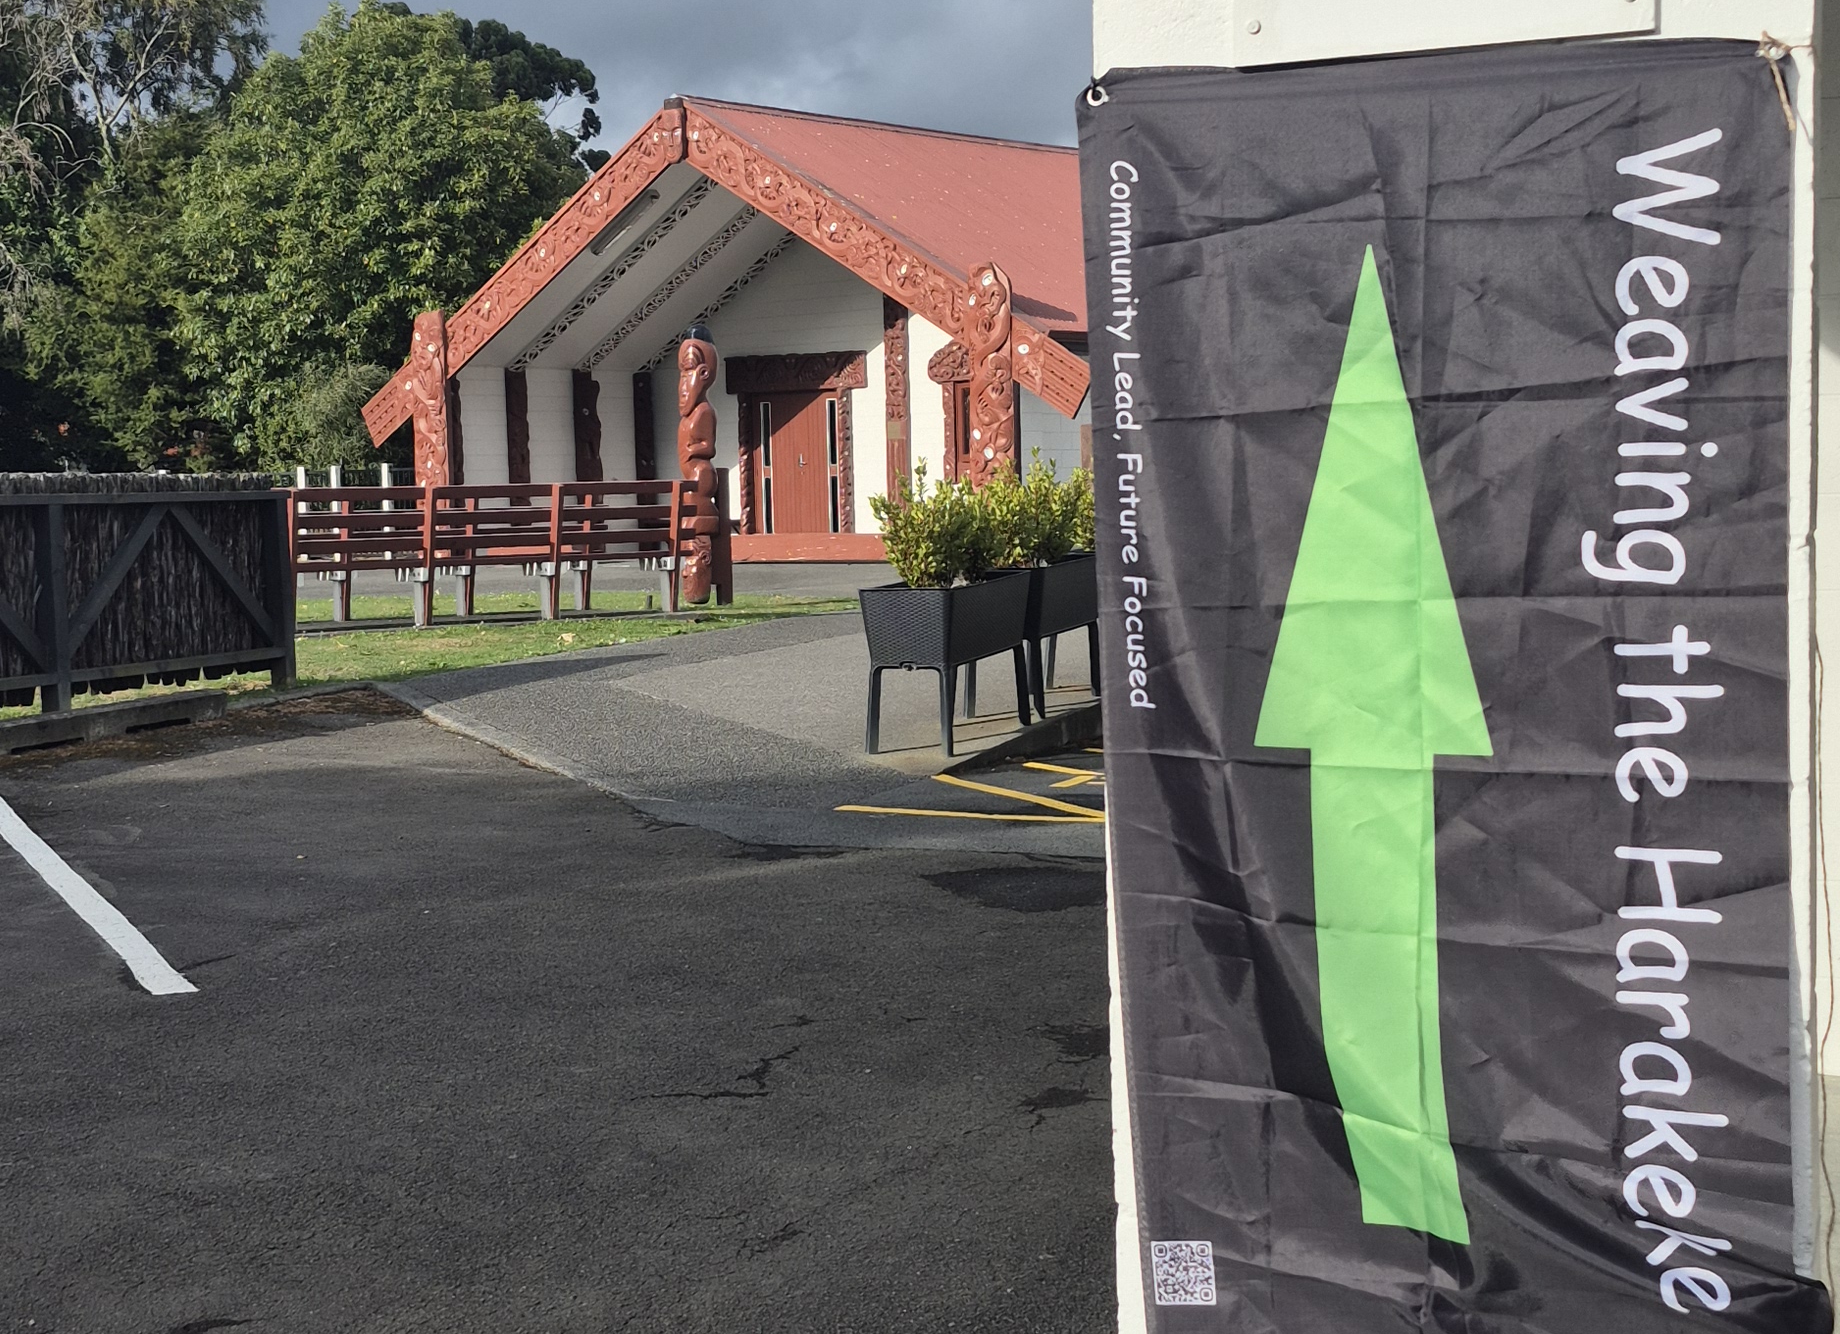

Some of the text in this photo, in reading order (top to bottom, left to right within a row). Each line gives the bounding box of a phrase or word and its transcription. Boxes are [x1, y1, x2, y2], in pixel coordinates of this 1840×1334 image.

[1105, 159, 1157, 709] Community Lead, Future Focused
[1581, 127, 1734, 1315] Weaving the Harakeke
